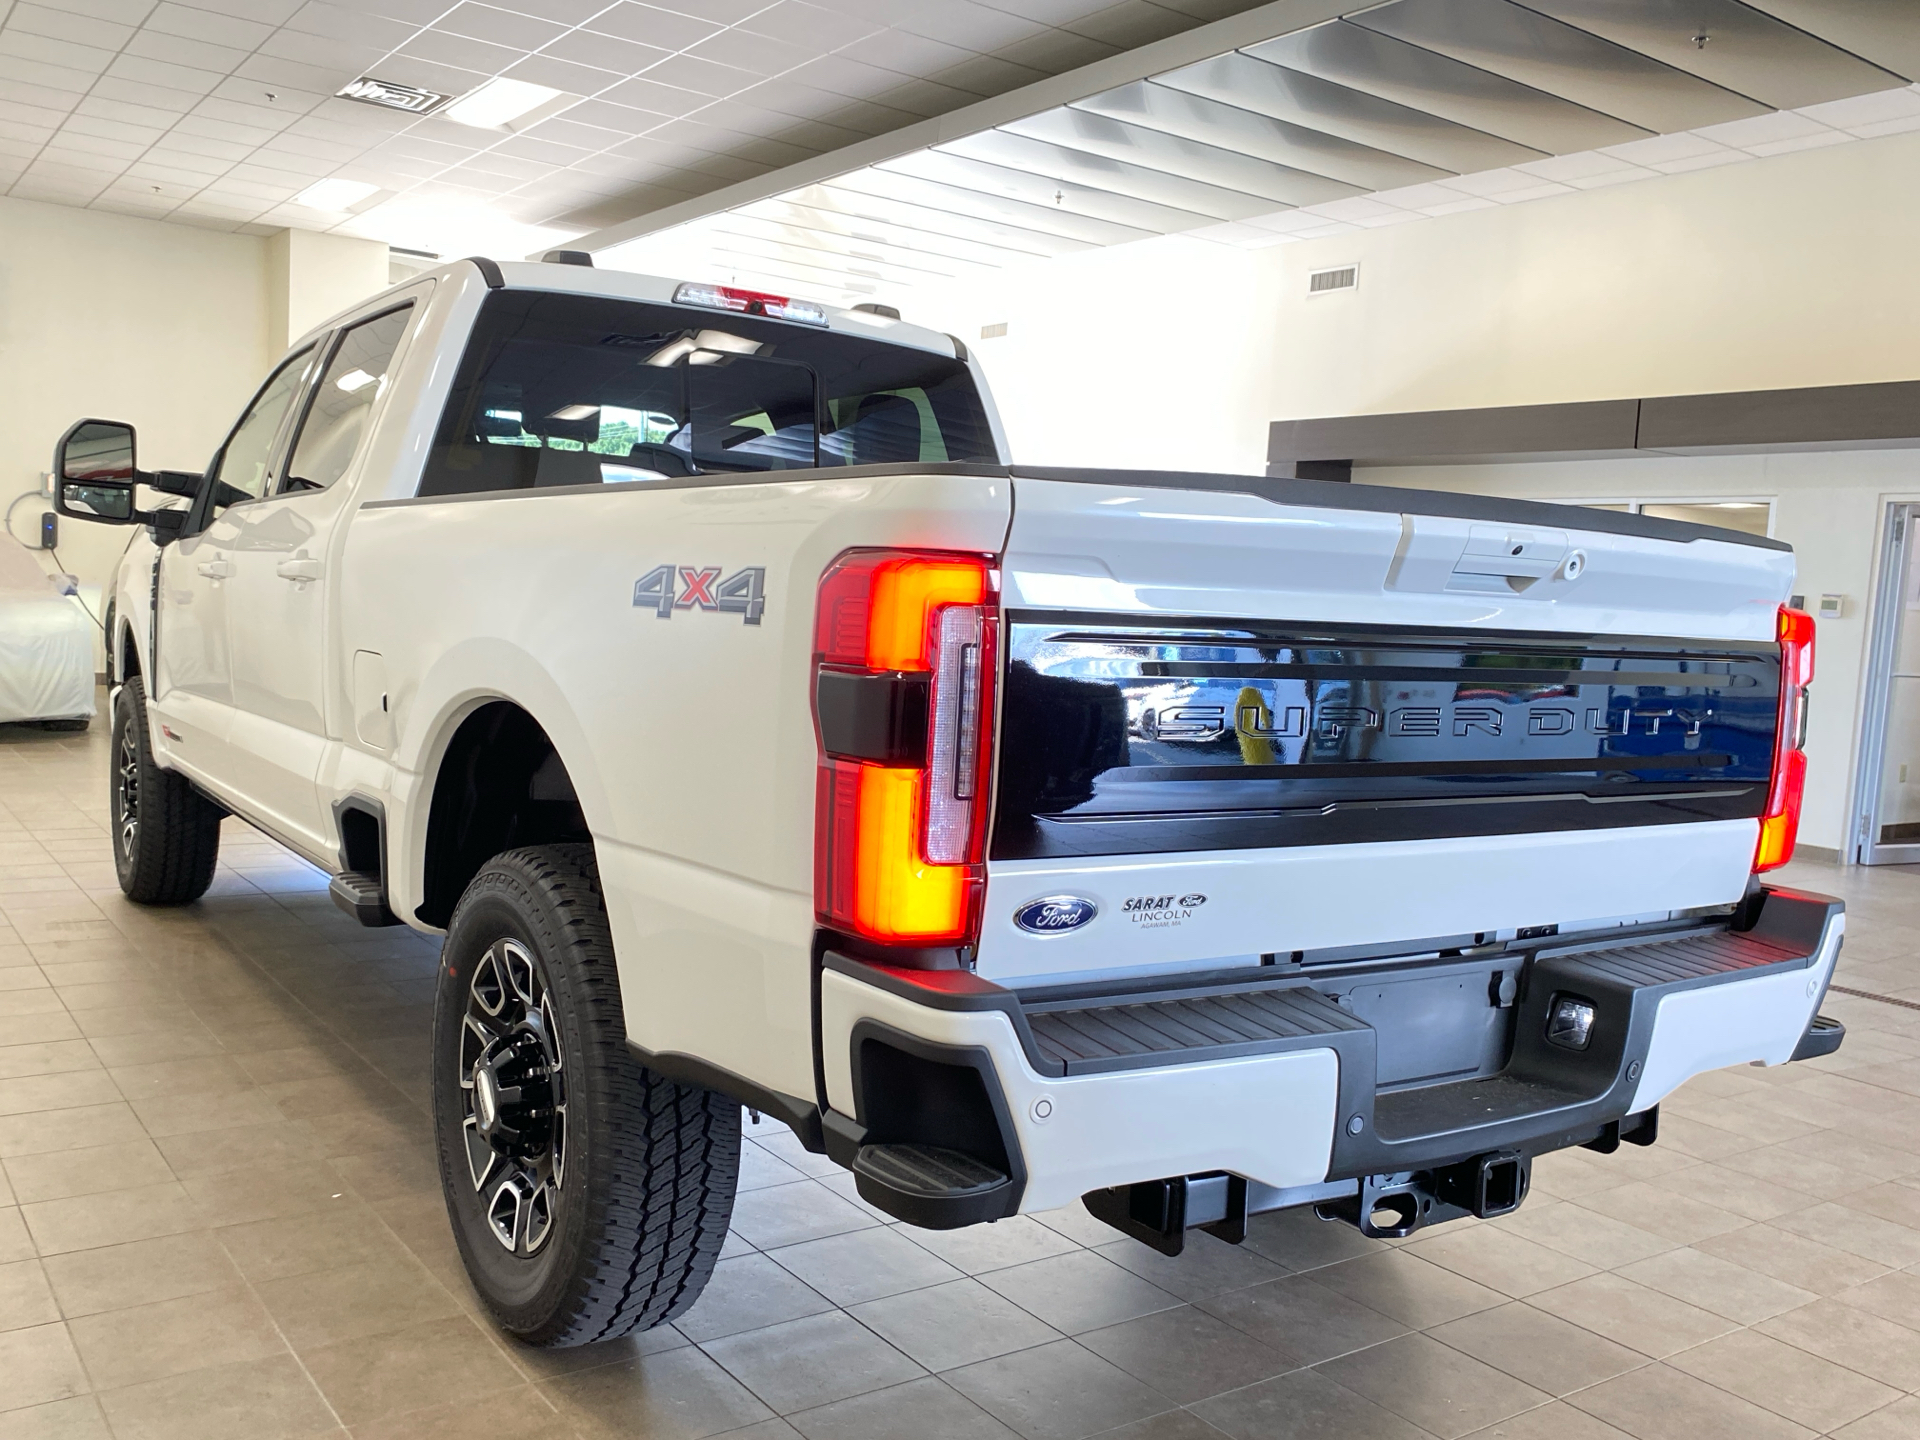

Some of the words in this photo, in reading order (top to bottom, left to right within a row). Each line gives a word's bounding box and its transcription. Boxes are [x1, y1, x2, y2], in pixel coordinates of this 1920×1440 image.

[1157, 705, 1503, 739] SUPER
[1527, 707, 1714, 737] DUTY
[1122, 895, 1175, 912] SARAT
[1181, 894, 1205, 907] Ford
[1036, 903, 1082, 928] Ford
[1131, 909, 1192, 923] LINCOLN
